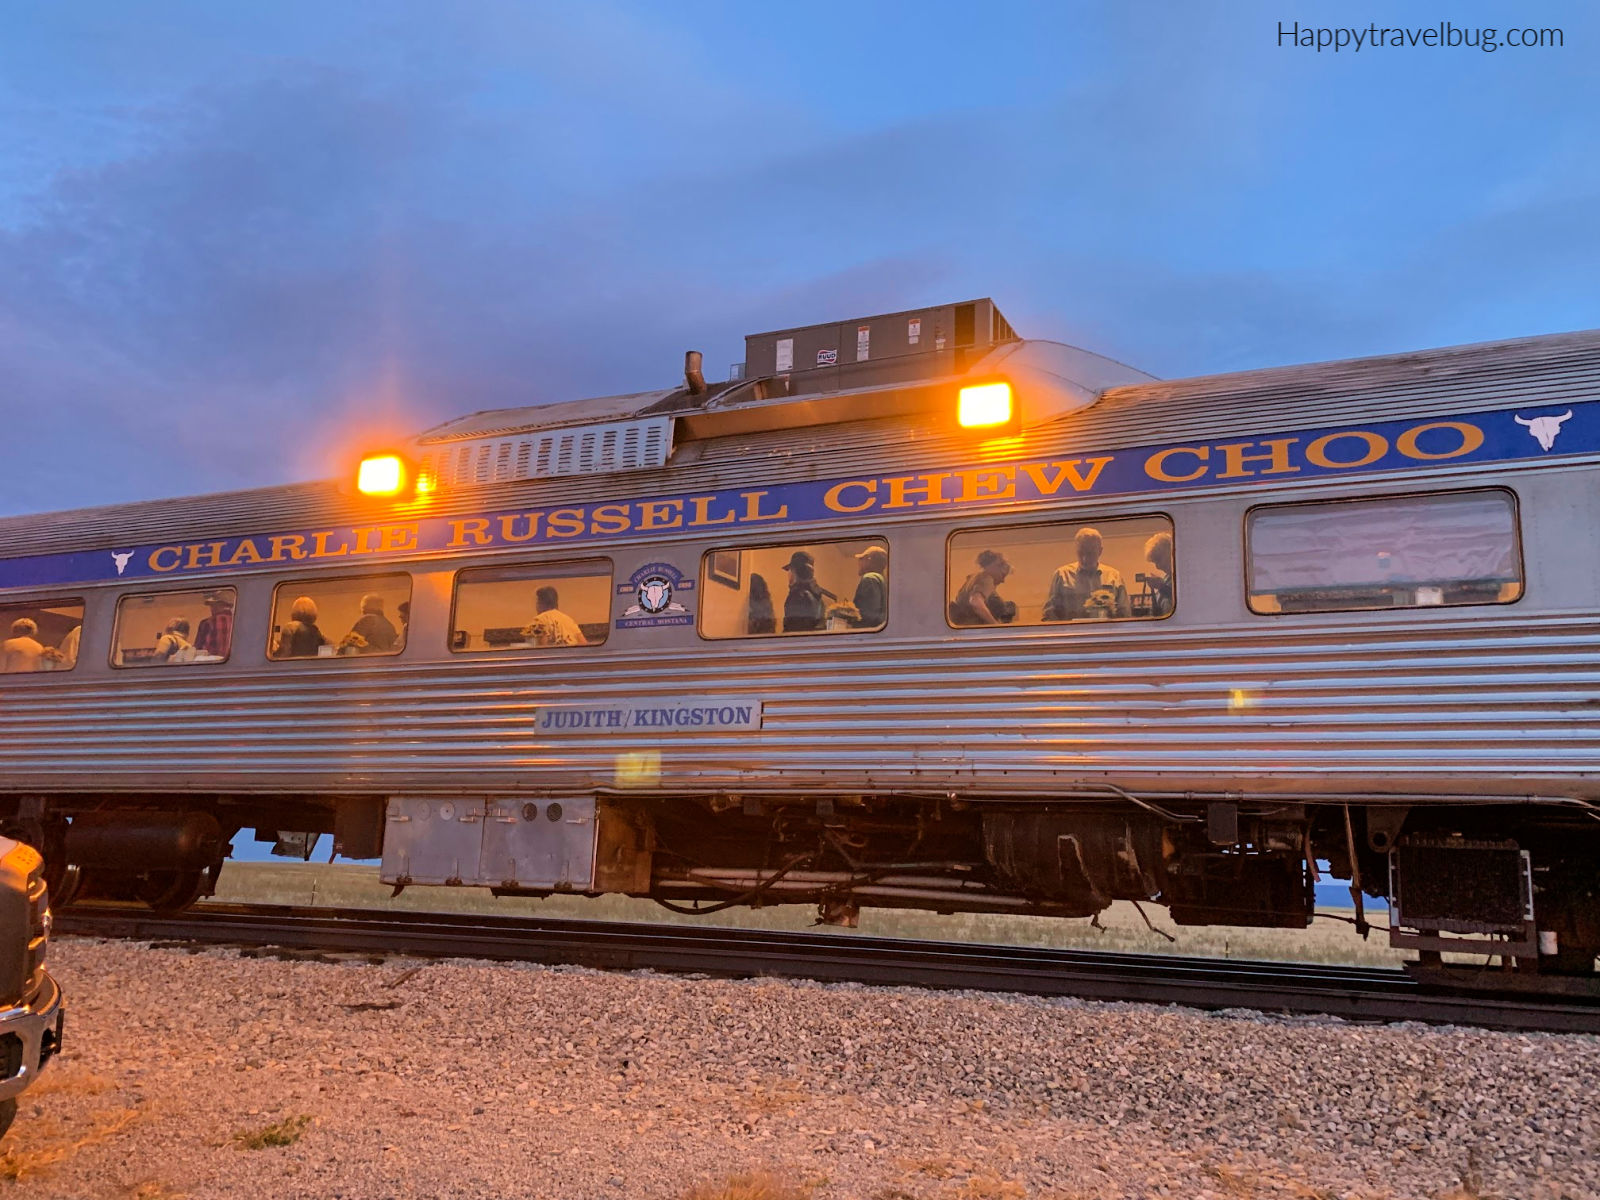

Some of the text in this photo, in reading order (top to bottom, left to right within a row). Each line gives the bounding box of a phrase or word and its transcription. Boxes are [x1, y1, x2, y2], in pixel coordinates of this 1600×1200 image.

[147, 421, 1485, 572] CHARLIE RUSSELL CHEW CHOO
[624, 617, 688, 627] CENTRAL MONTANA
